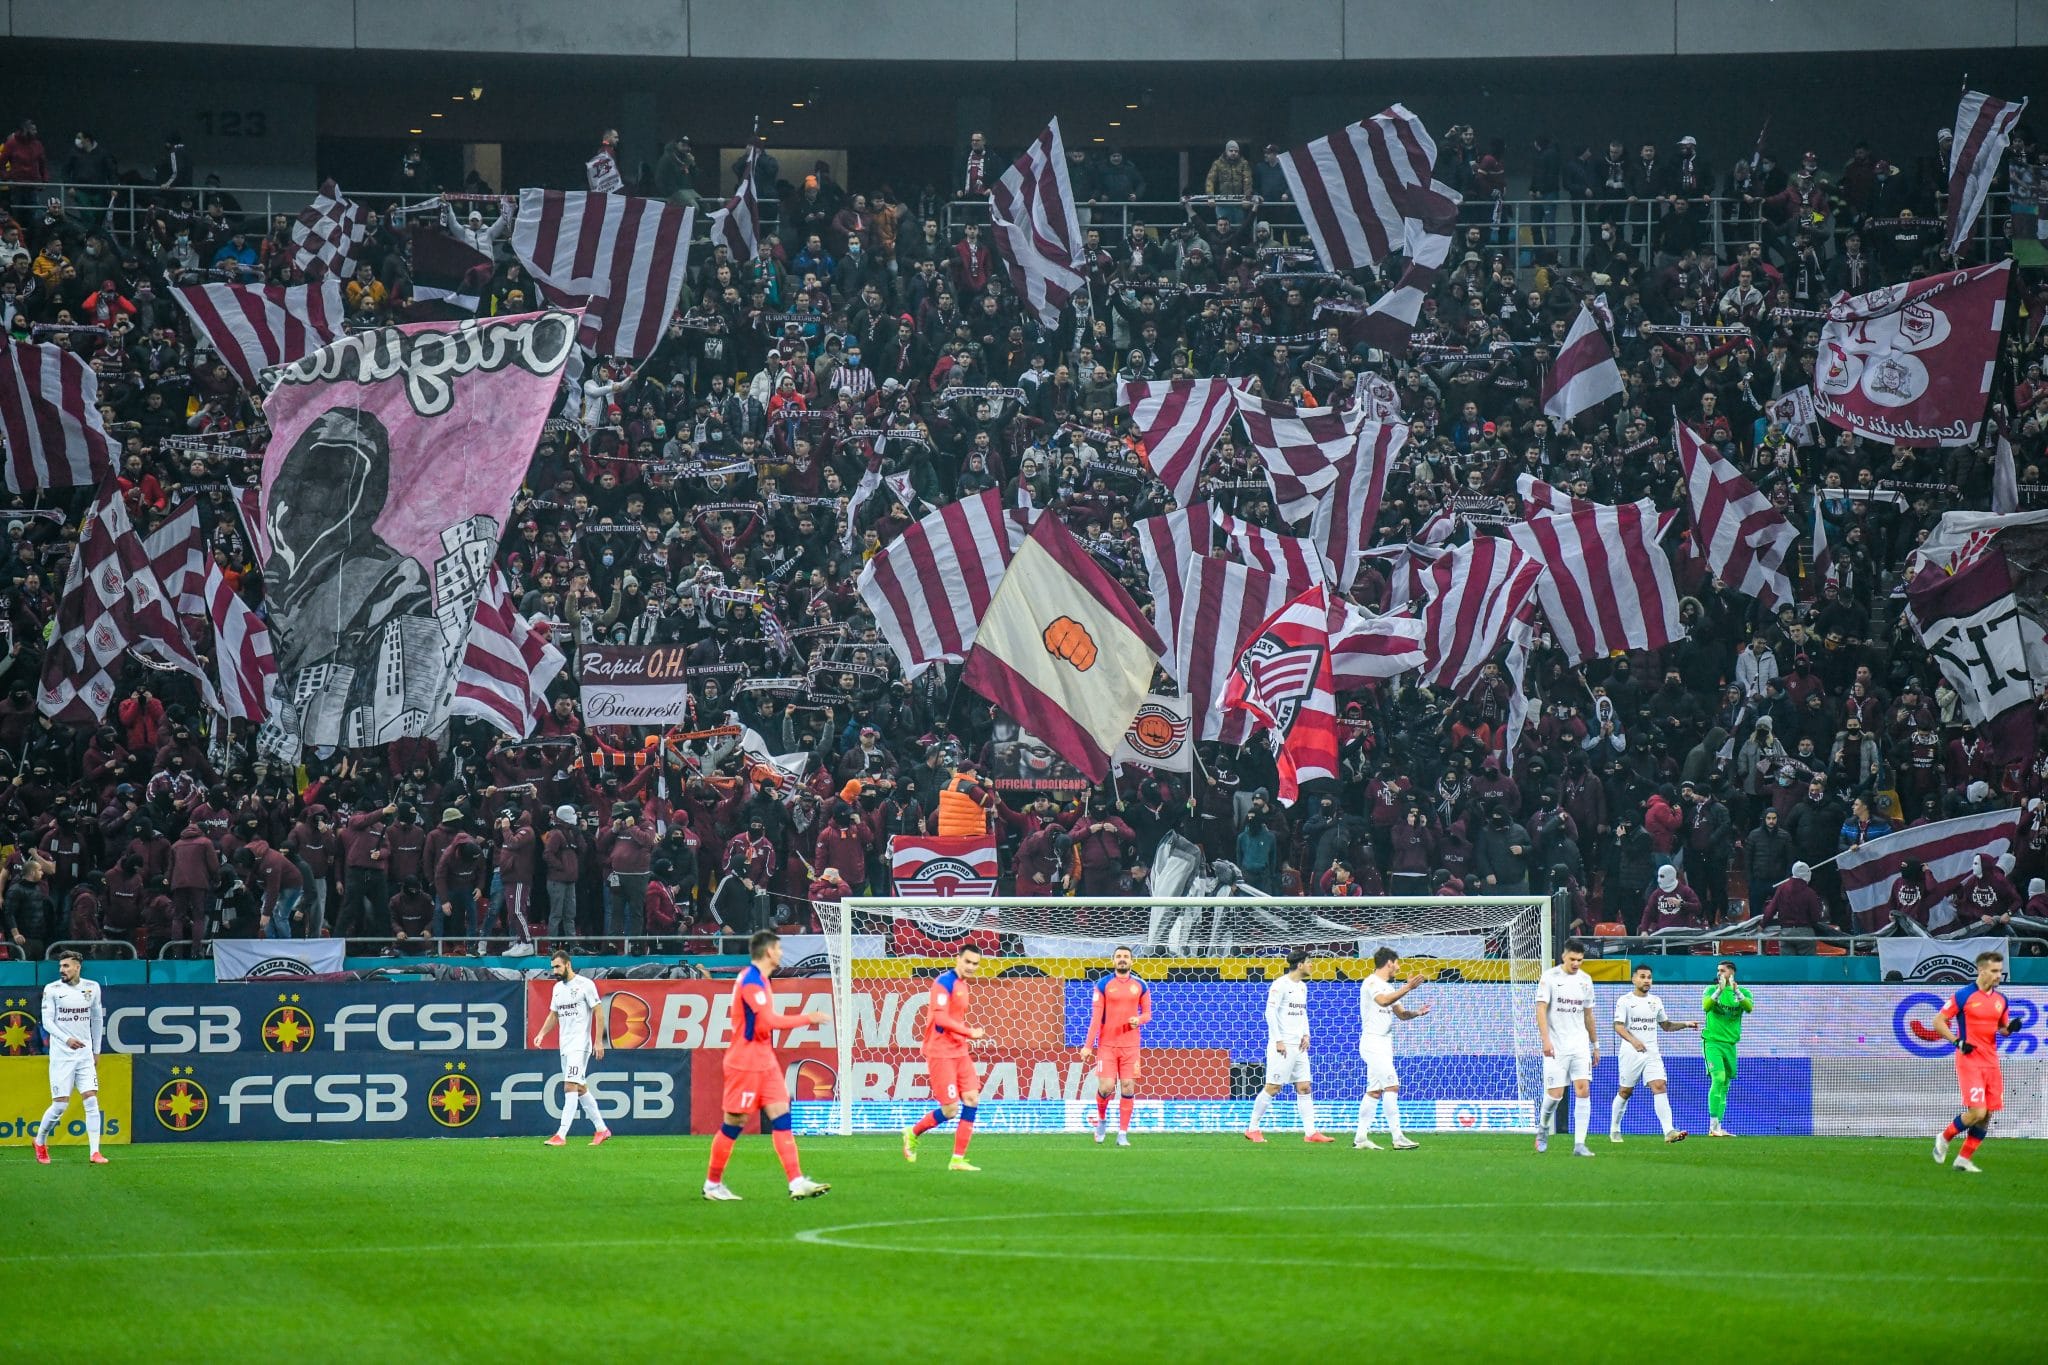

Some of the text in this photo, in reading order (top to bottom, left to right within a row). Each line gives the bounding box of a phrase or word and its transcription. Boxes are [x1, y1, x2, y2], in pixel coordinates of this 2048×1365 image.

[201, 110, 267, 137] 123
[780, 410, 821, 418] RAPID
[653, 463, 670, 472] POLI
[1090, 461, 1106, 470] POLI
[1115, 464, 1138, 475] RAPID
[582, 648, 684, 680] Rapid O.H.
[699, 665, 743, 674] BUCURESTI
[587, 692, 682, 719] Bucuresti
[994, 777, 1087, 791] OFFICIAL HOOLIGANS
[921, 863, 970, 877] PELUZA NORD
[252, 960, 309, 976] PELUZA NORD
[1917, 957, 1974, 975] PELUZA NORD
[101, 1006, 242, 1054] CSB
[325, 1003, 508, 1052] FCSB
[567, 1066, 579, 1076] 30
[218, 1073, 409, 1124] FCSB
[490, 1071, 674, 1120] FCSB
[741, 1091, 755, 1108] 17
[946, 1083, 957, 1100] 8
[1969, 1087, 1985, 1103] 27
[0, 1111, 120, 1137] otor ols
